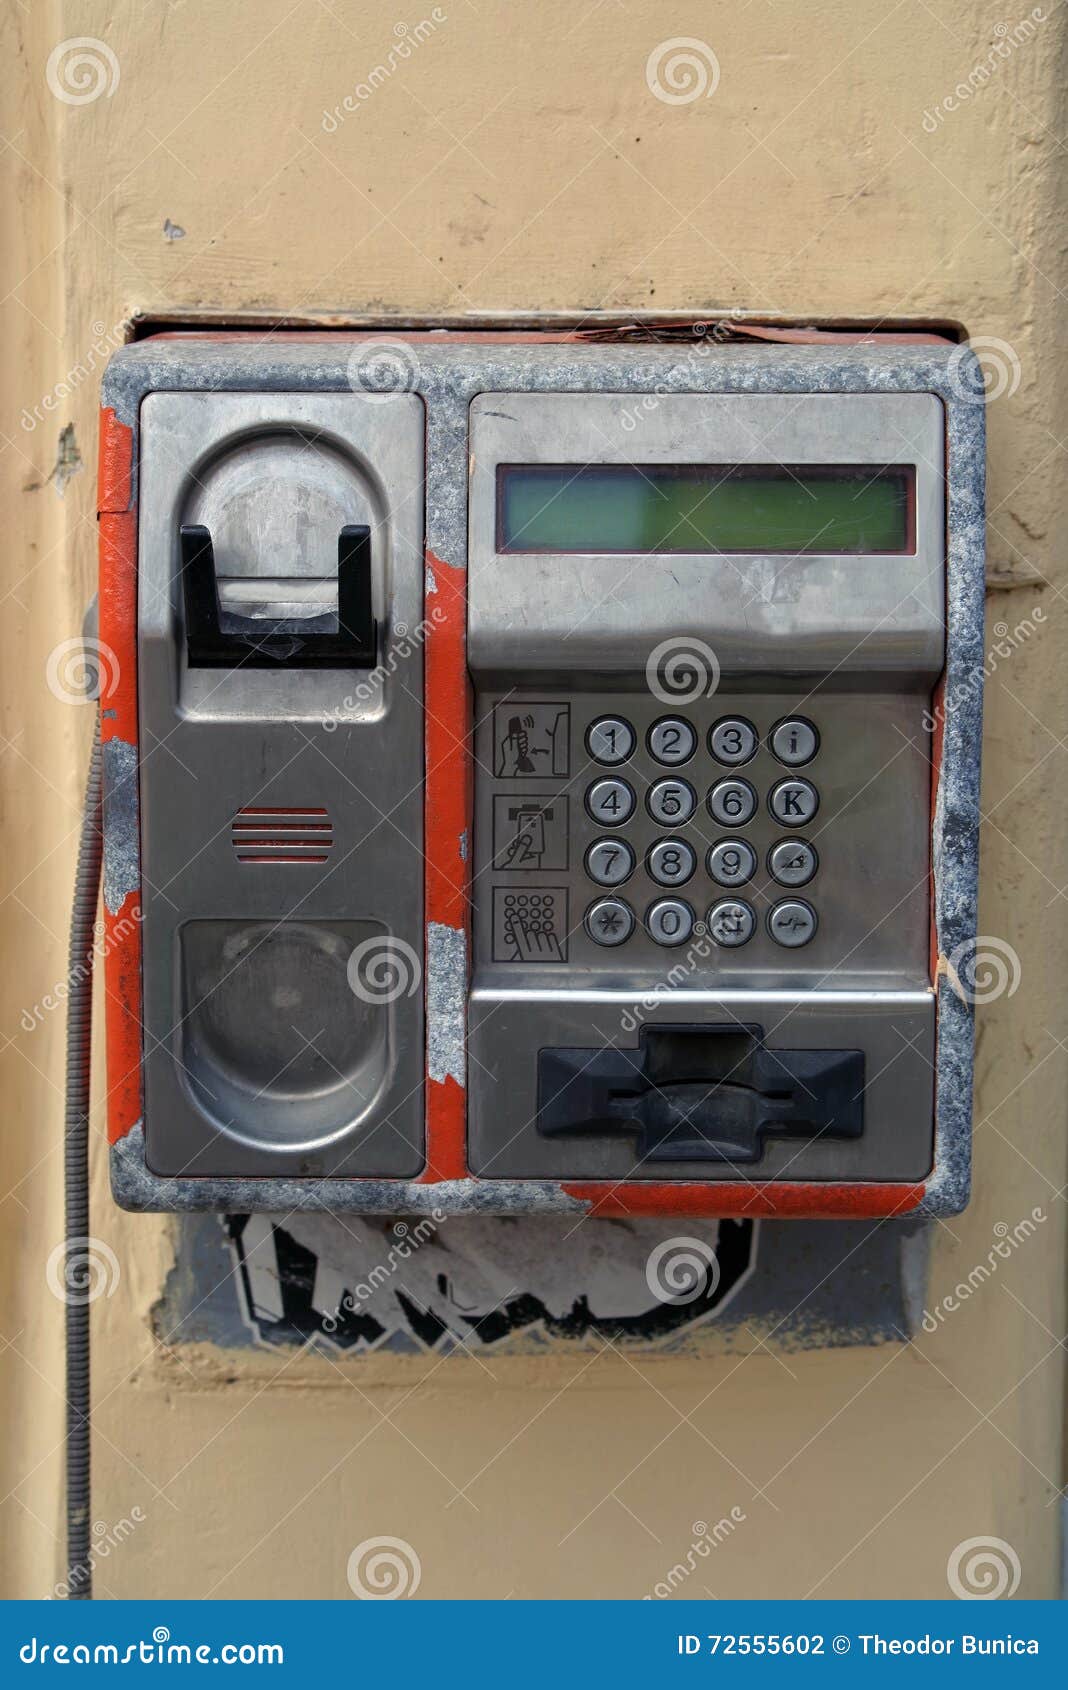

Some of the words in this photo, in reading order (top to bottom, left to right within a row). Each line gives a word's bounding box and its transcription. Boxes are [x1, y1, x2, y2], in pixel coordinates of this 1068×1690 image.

[604, 728, 616, 754] 1
[661, 728, 681, 755] 2
[721, 728, 742, 755] 3
[790, 731, 798, 754] i
[600, 790, 621, 815] 4
[661, 789, 681, 816] 5
[722, 790, 743, 816] 6
[782, 790, 806, 816] K
[600, 849, 620, 875] 7
[660, 850, 681, 876] 8
[721, 850, 741, 876] 9
[660, 909, 681, 936] 0
